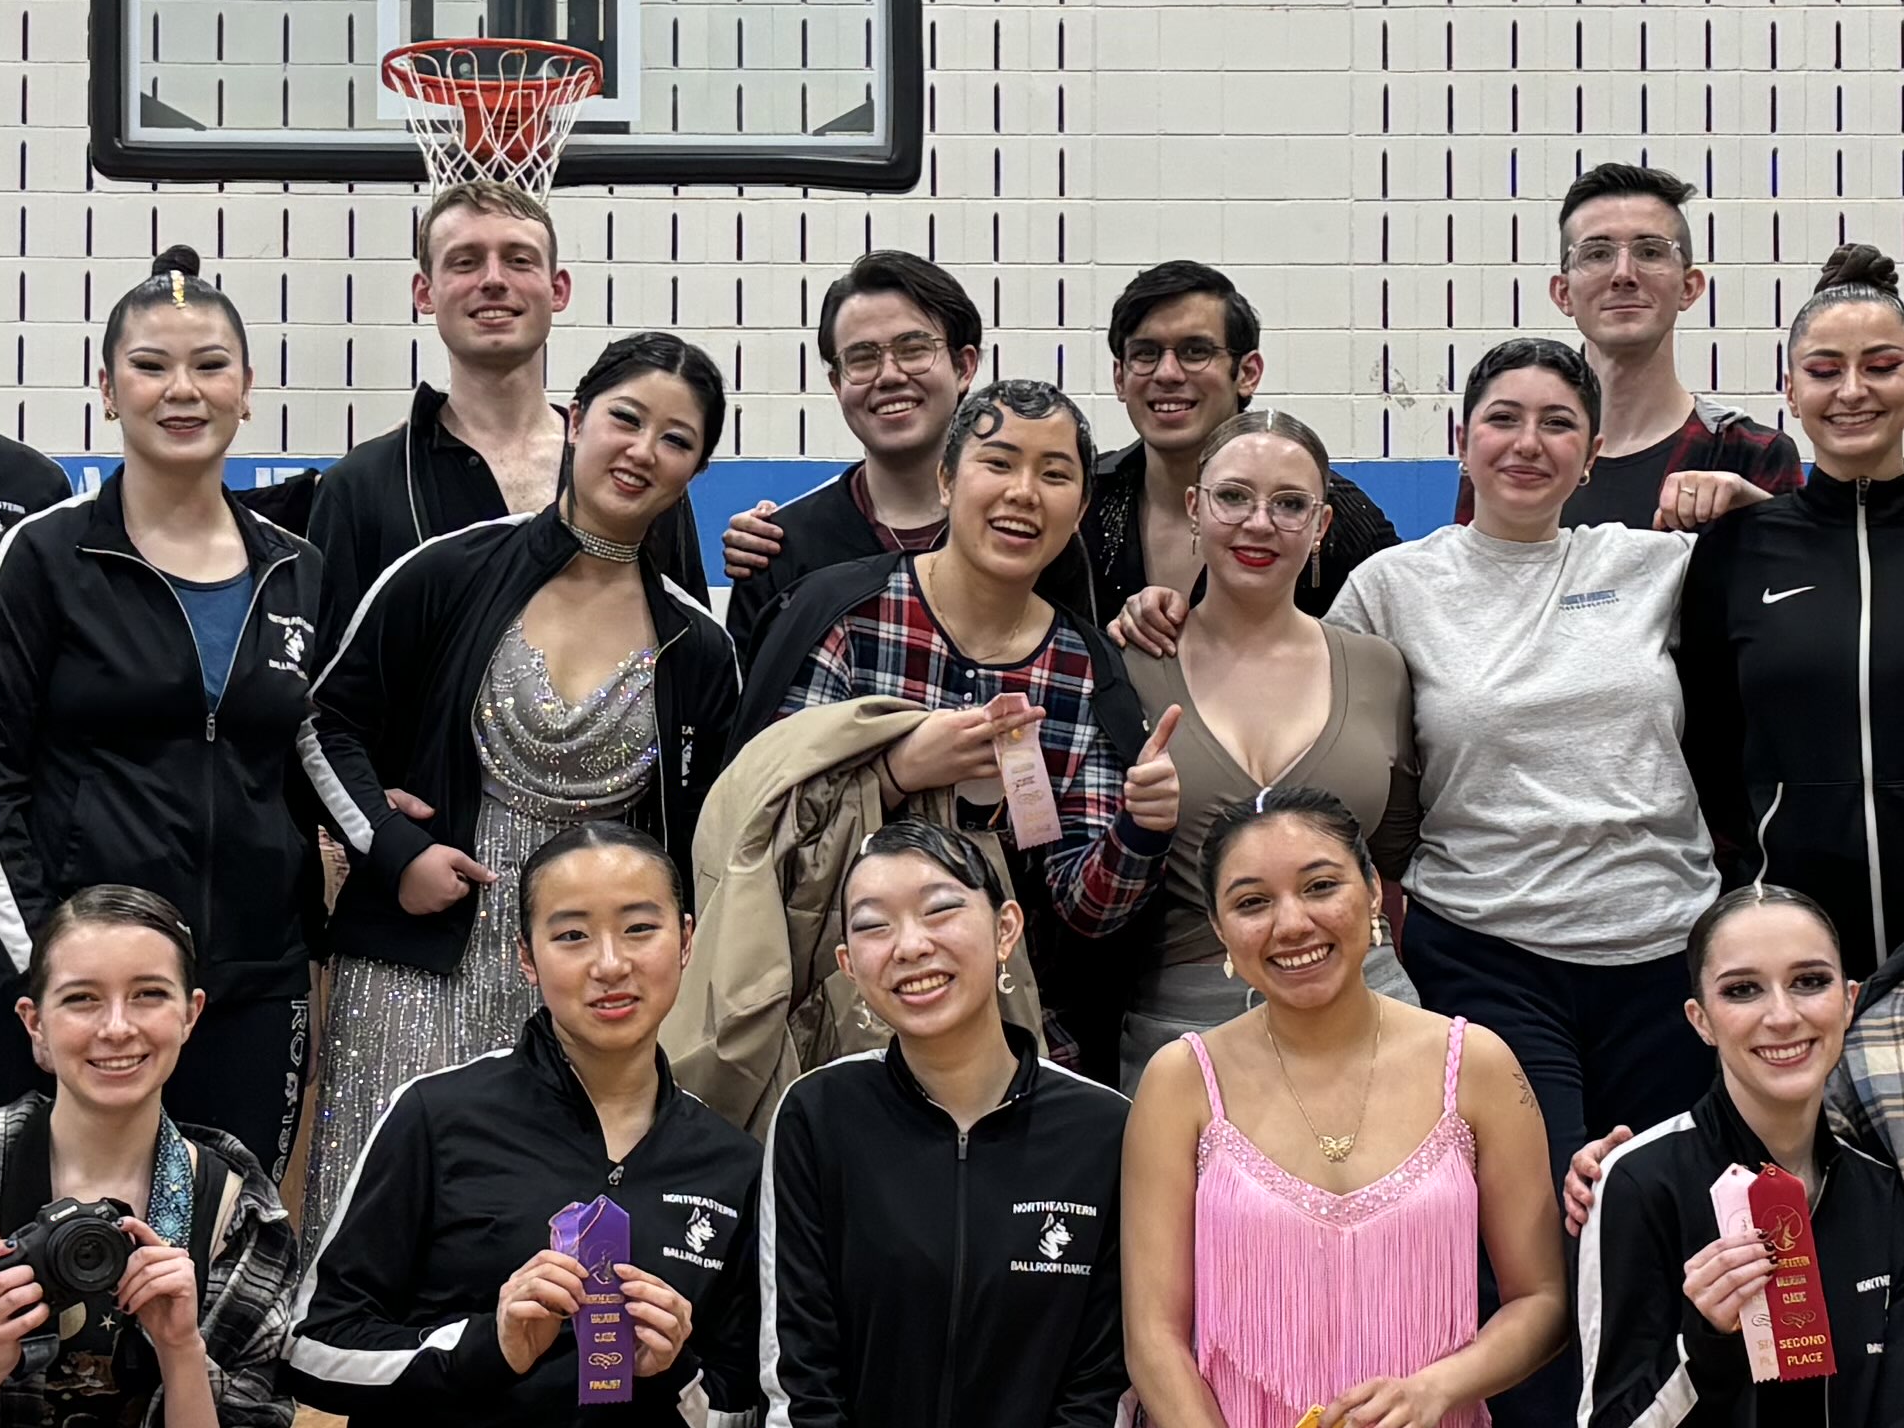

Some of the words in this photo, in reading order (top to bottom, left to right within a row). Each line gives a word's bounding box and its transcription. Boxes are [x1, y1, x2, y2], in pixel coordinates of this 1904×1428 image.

[1012, 1200, 1097, 1217] NORTHEASTERN
[1010, 1260, 1062, 1274] BALLROOM
[1779, 1334, 1827, 1350] SECOND
[1786, 1351, 1824, 1367] PLACE
